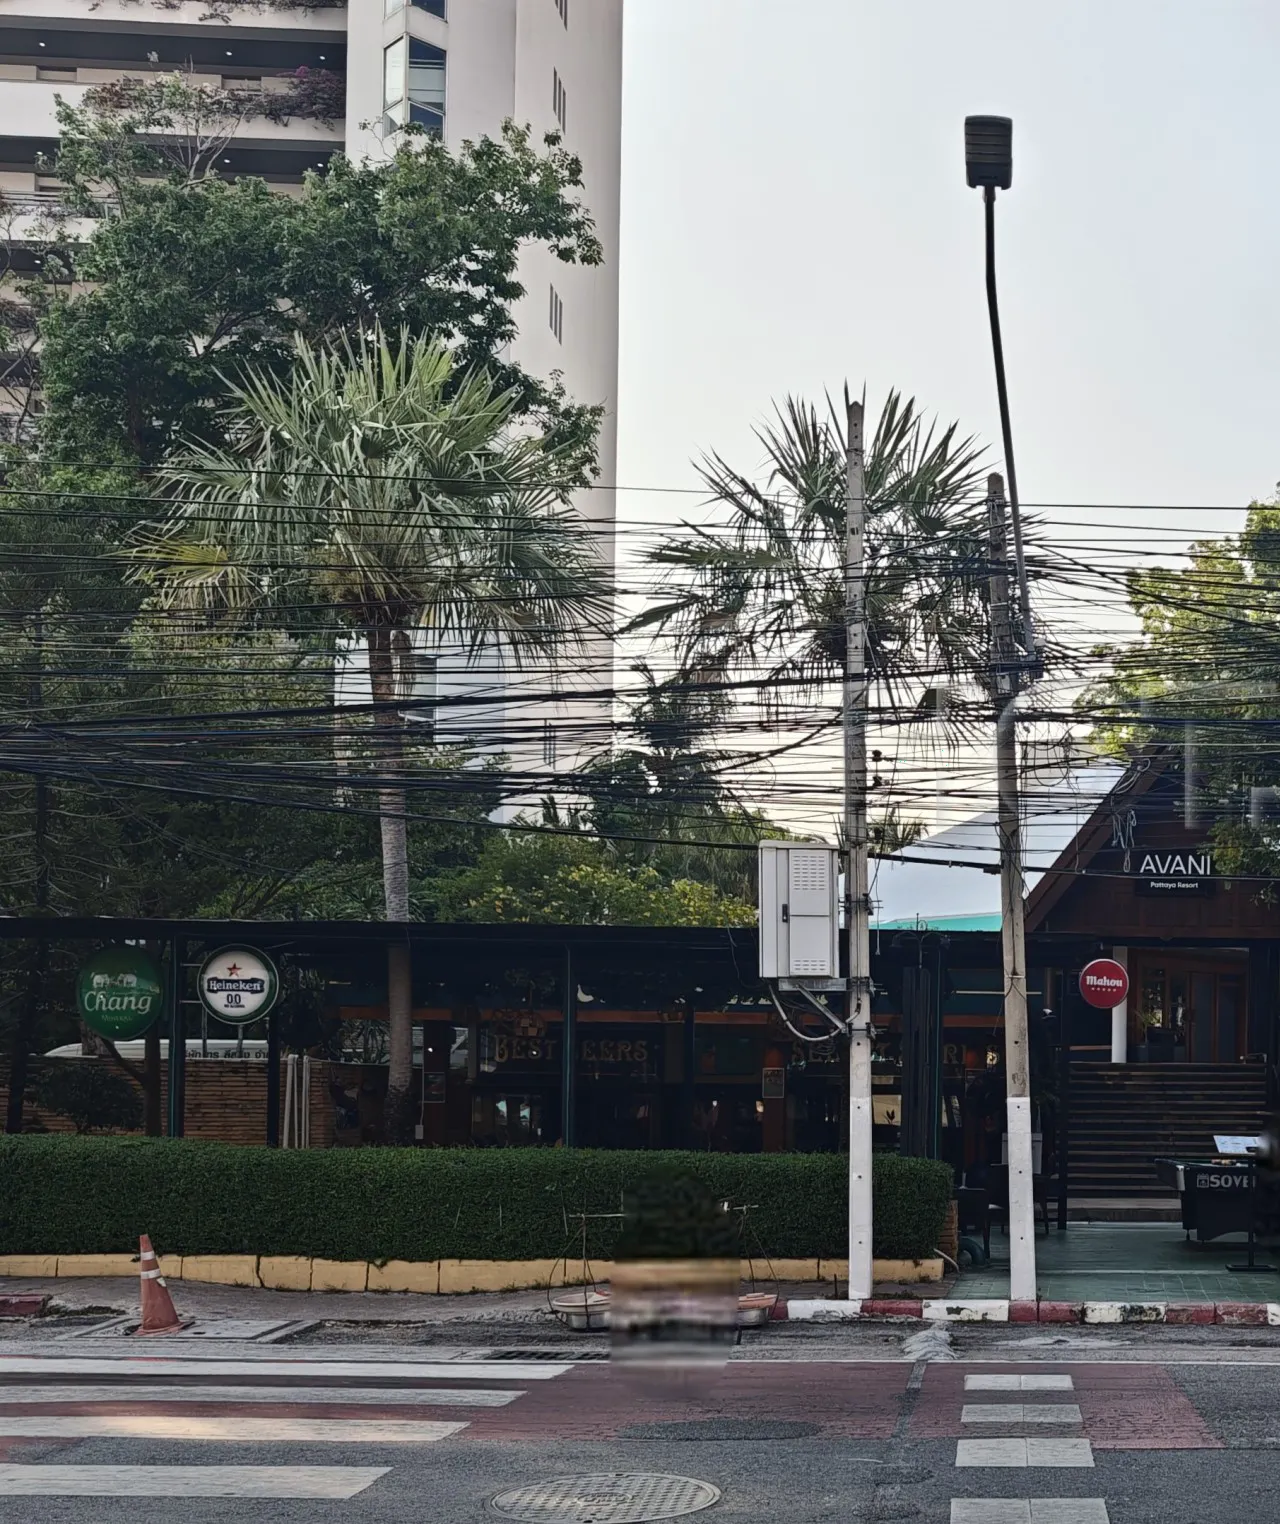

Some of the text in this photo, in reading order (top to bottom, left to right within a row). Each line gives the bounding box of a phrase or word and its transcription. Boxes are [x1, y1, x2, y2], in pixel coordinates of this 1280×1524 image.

[1139, 853, 1211, 876] AVANI
[1149, 881, 1199, 891] Pattaya Resort
[209, 979, 261, 992] Heineken
[1085, 974, 1123, 988] Mahou
[83, 990, 153, 1015] Chang
[581, 1039, 649, 1062] EERS
